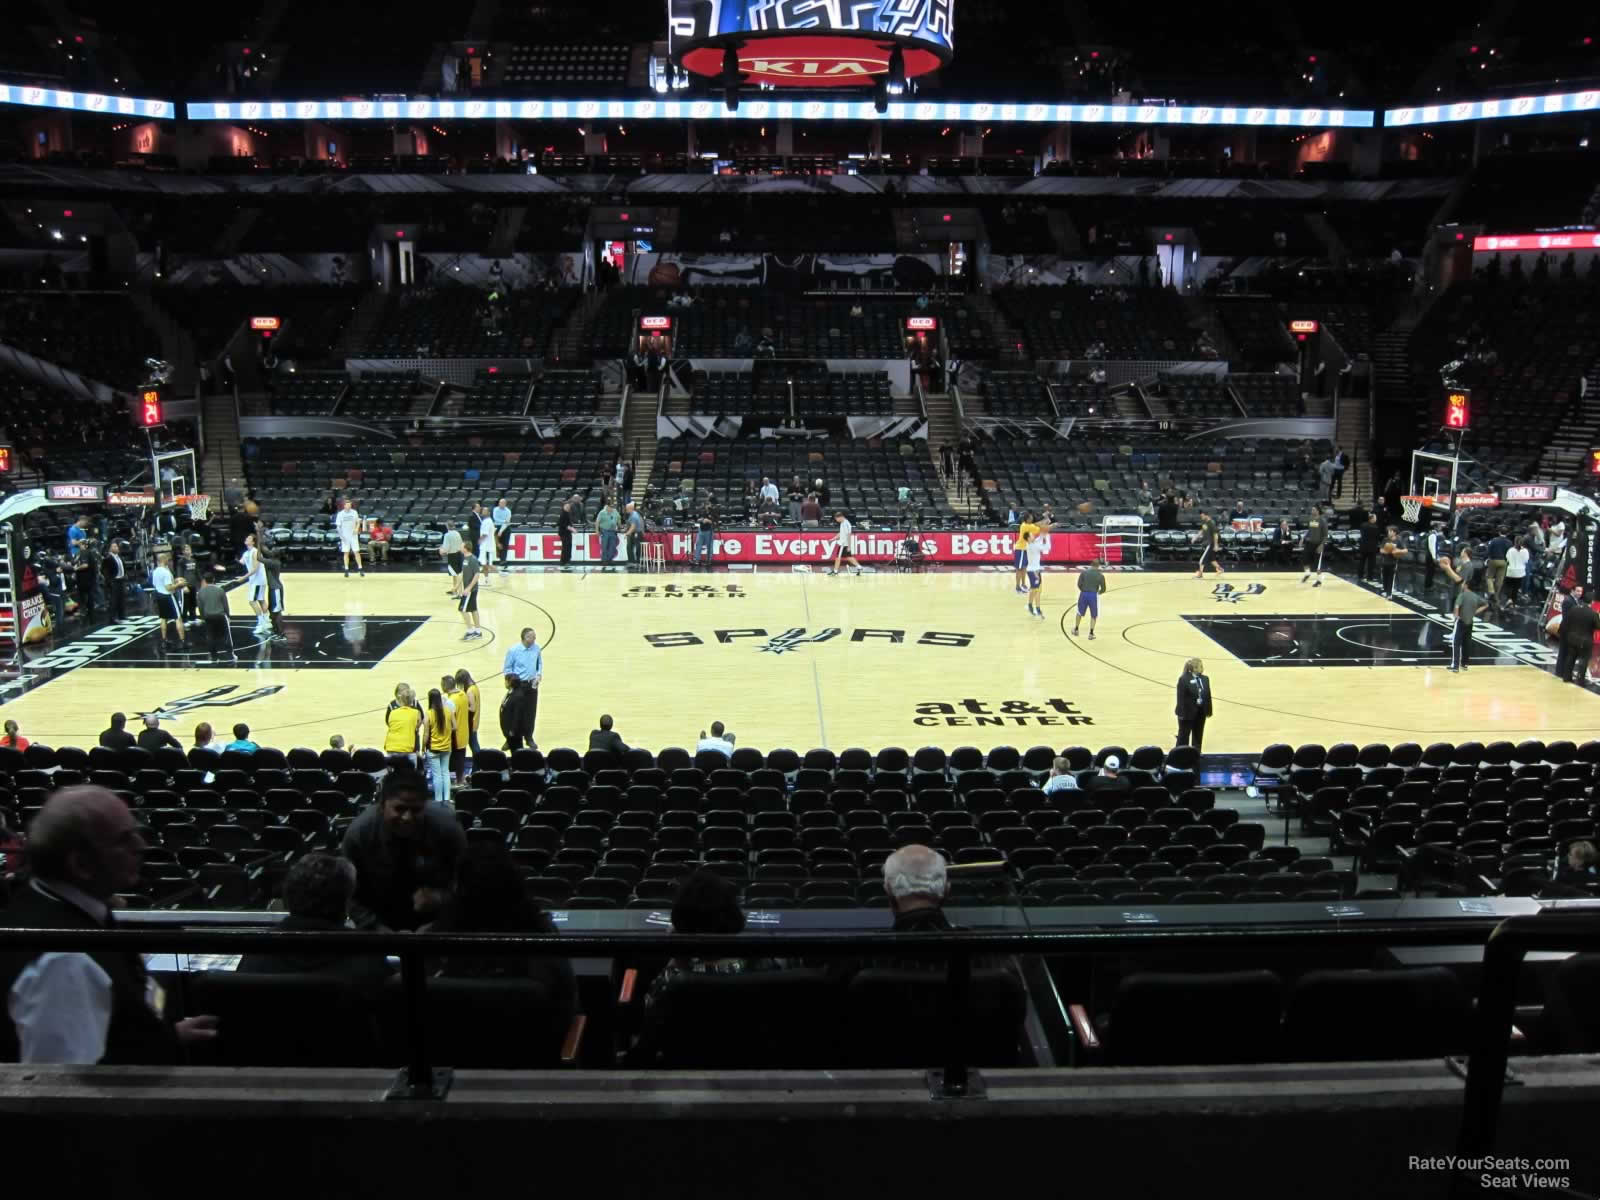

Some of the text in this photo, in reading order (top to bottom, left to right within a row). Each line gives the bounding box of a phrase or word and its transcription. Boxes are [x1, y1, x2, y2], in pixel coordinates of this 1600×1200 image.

[752, 60, 868, 74] KIA
[145, 404, 159, 424] 24
[1449, 406, 1464, 427] 24
[672, 534, 742, 555] Hre
[755, 534, 938, 560] Everyhing's
[1586, 534, 1596, 585] WORLD CAR
[21, 593, 44, 609] BRAKE
[22, 615, 163, 669] SPURS
[915, 698, 1083, 715] at&t
[913, 716, 1096, 727] CENTER
